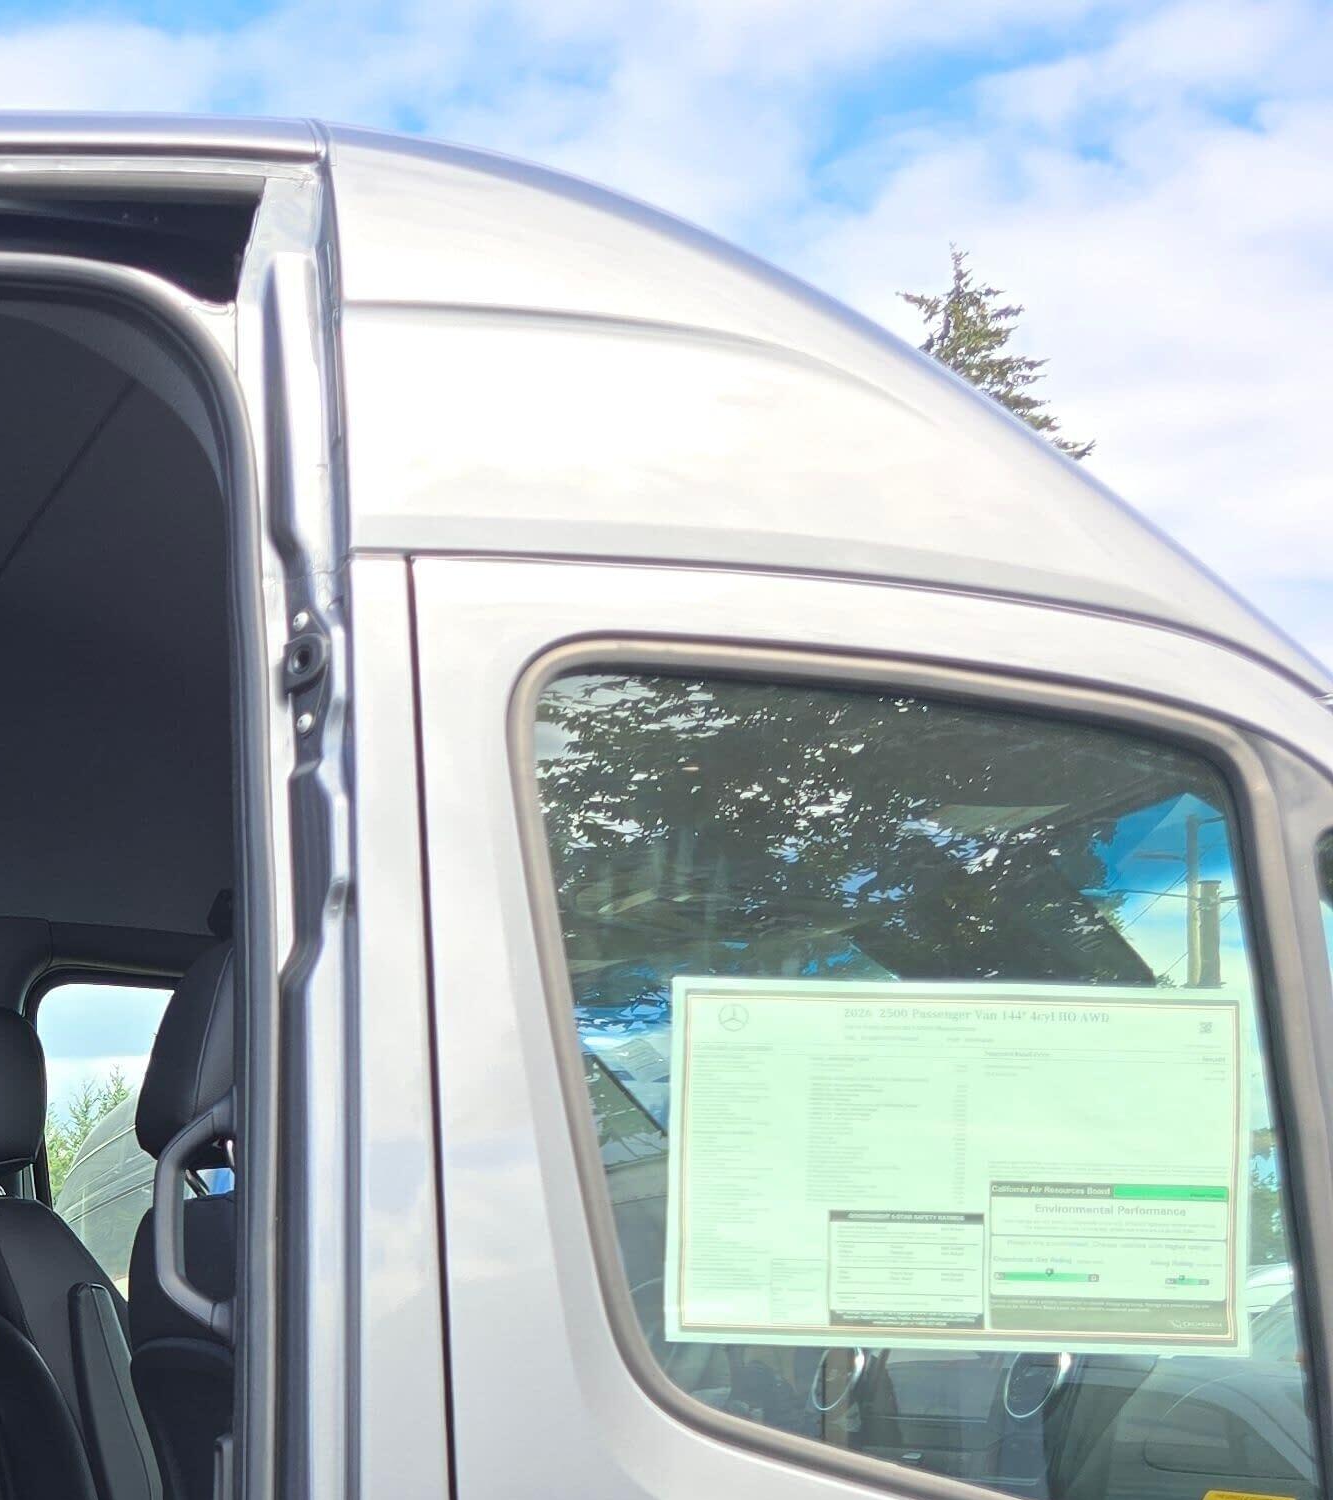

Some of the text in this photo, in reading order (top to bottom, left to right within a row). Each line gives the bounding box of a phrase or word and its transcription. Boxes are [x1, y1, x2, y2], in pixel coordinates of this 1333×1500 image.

[879, 1008, 908, 1019] 2500
[913, 1008, 973, 1022] Passenger
[975, 1010, 997, 1021] Van
[1080, 1012, 1110, 1023] AWD
[991, 1185, 1030, 1193] California
[1044, 1186, 1085, 1194] Resources
[1035, 1203, 1187, 1217] Environmental Performance
